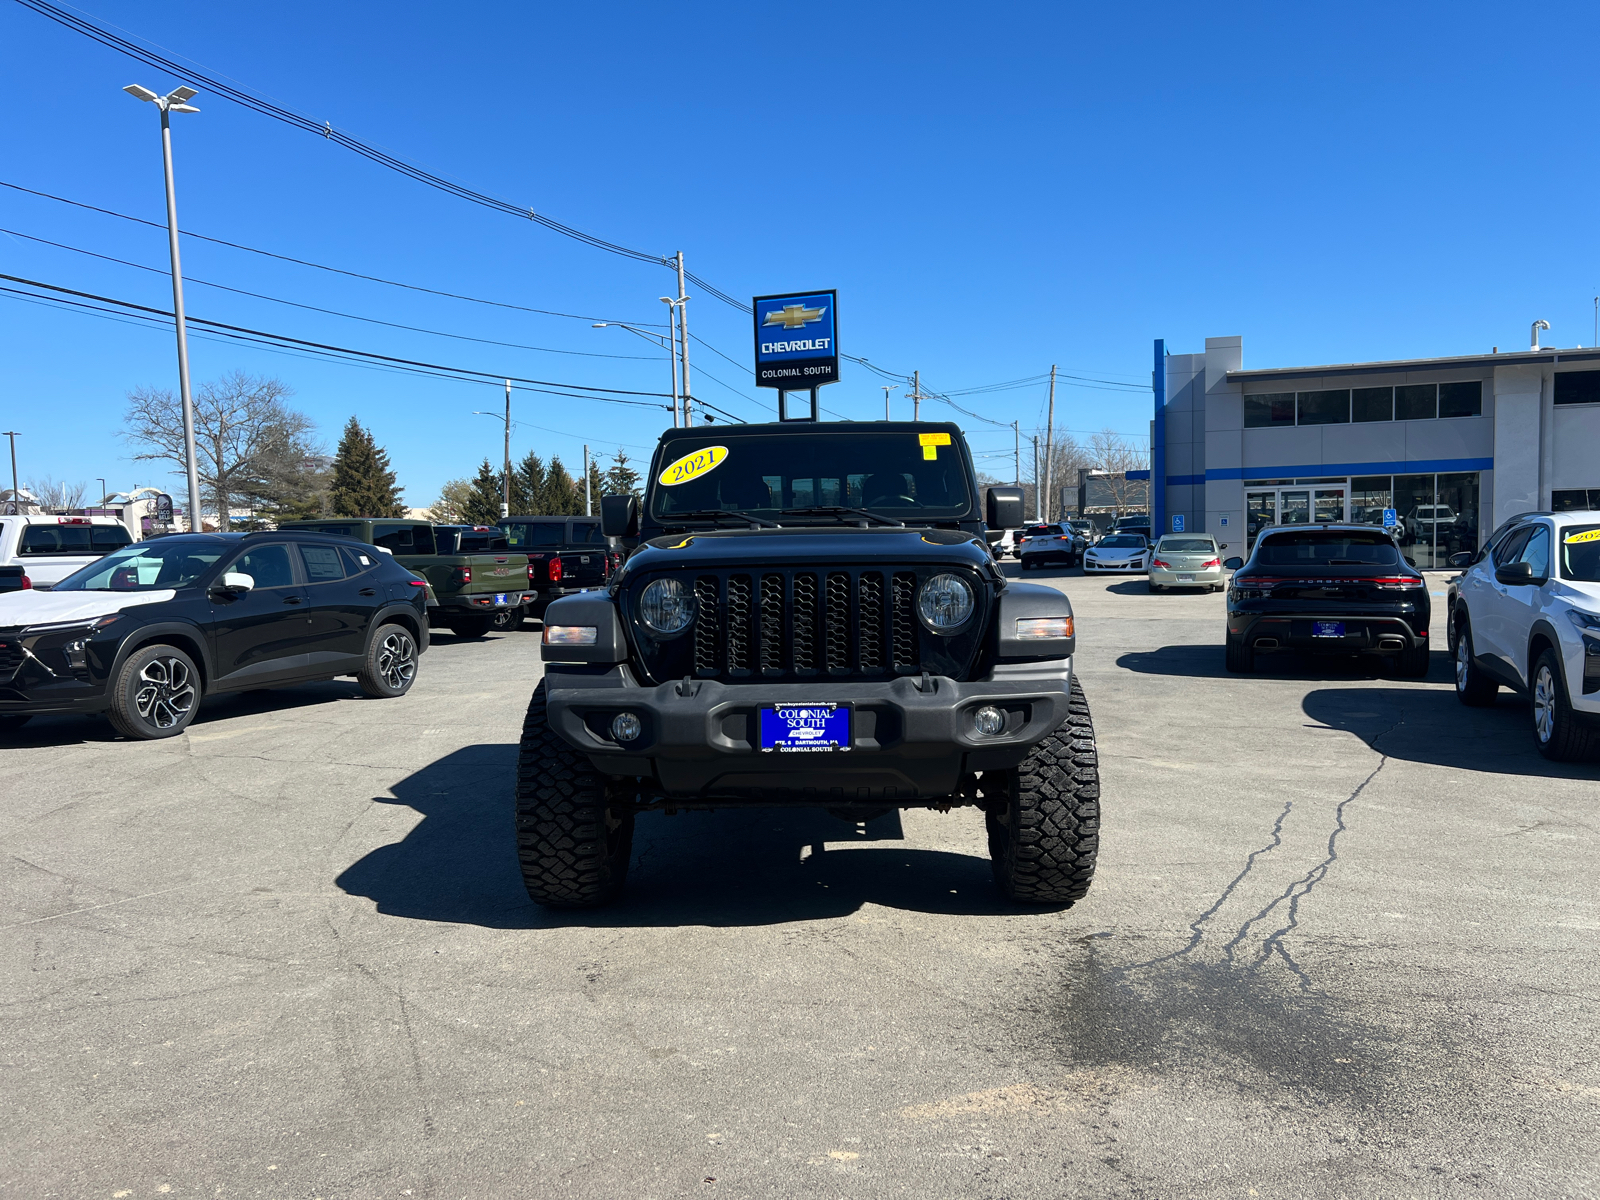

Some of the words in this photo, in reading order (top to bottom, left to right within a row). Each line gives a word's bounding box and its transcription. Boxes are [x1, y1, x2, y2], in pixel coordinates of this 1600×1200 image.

[761, 338, 831, 354] CHEVROLET
[761, 368, 802, 379] COLONIAL
[804, 366, 832, 376] SOUTH
[672, 450, 716, 482] 2021
[1576, 532, 1600, 542] 202
[778, 709, 834, 719] COLONIAL
[787, 719, 826, 728] SOUTH
